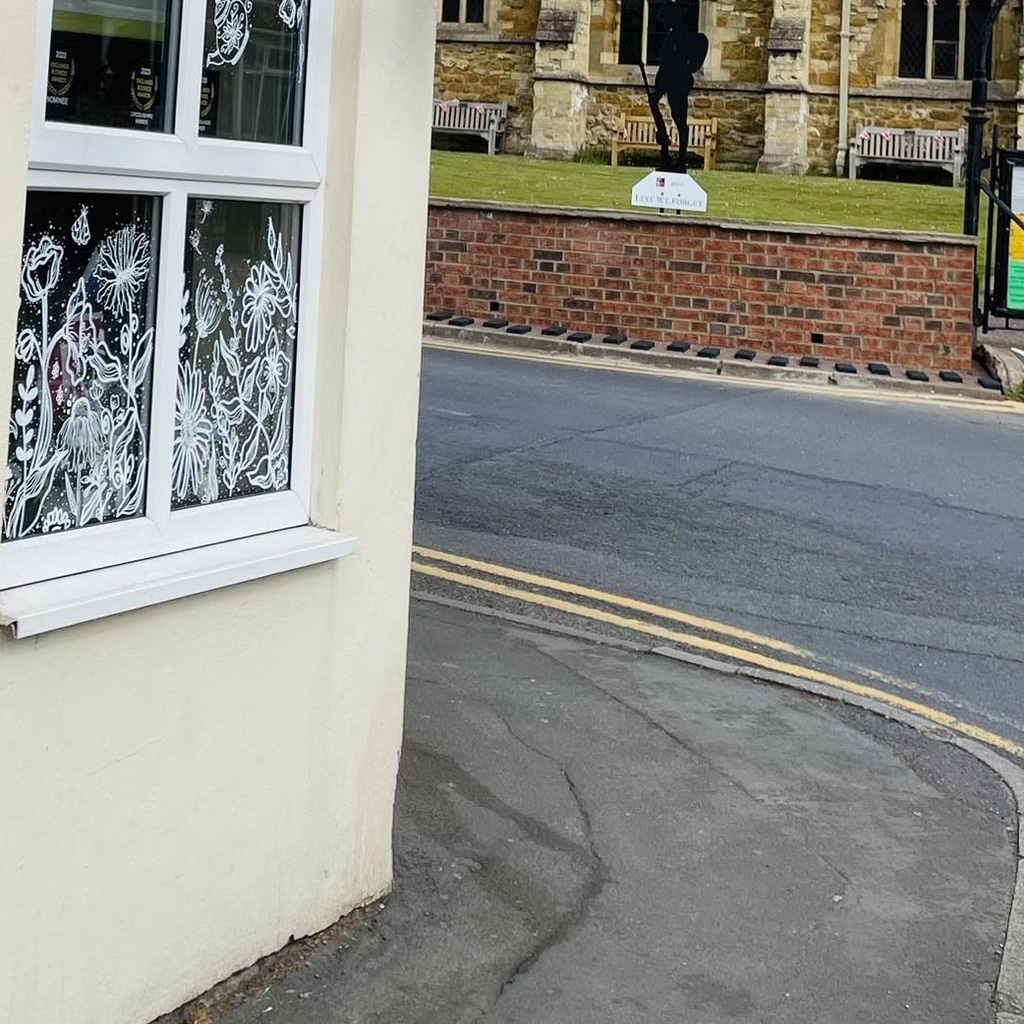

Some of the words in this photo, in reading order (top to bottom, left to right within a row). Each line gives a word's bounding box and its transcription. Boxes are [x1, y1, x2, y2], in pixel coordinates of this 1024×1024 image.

[46, 96, 68, 106] NOMINEE
[656, 196, 668, 205] WE
[671, 197, 703, 208] FORGET
